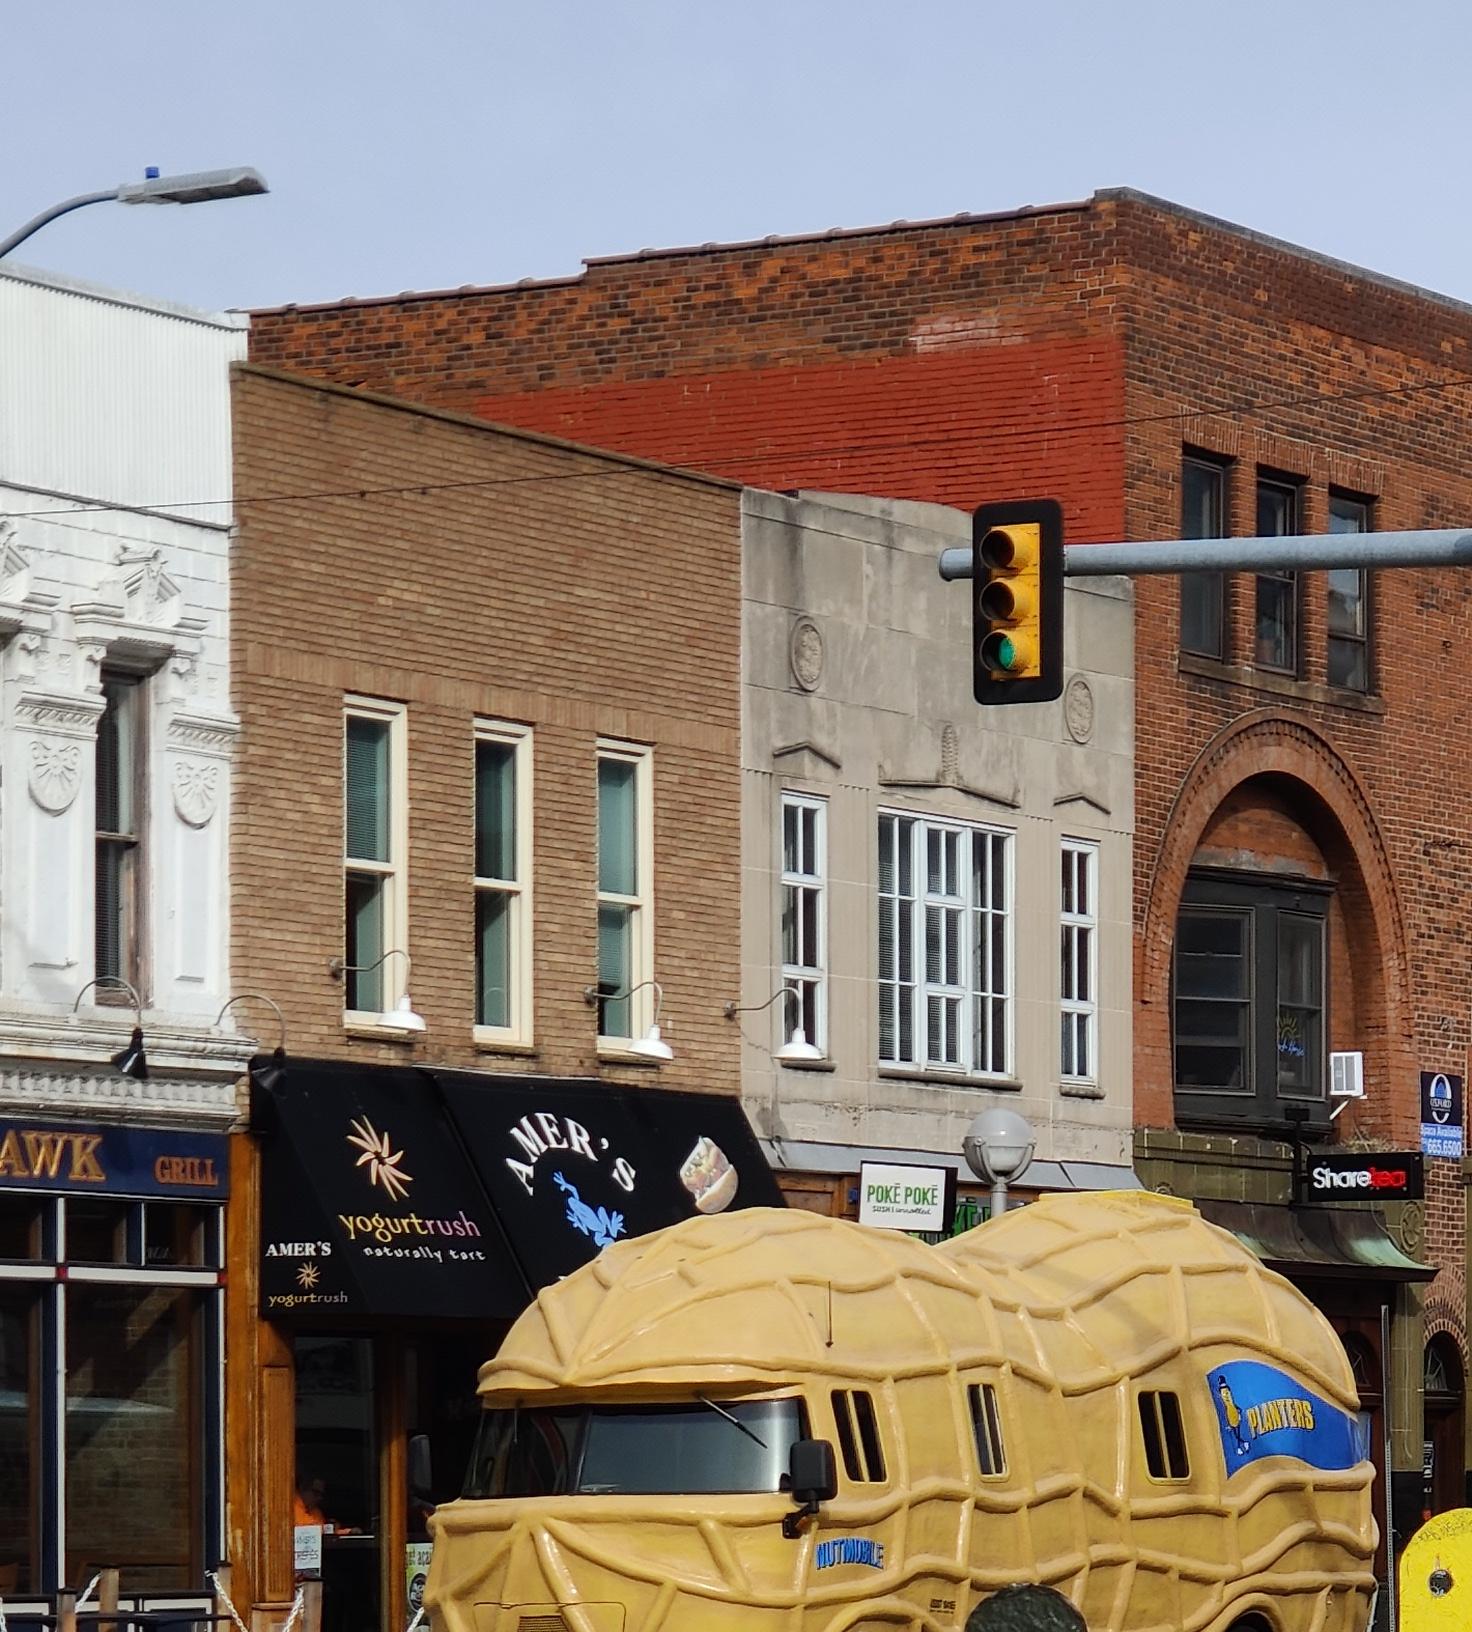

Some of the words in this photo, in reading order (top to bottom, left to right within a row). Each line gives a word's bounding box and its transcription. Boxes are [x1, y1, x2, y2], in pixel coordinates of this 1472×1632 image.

[505, 1112, 637, 1196] AMER'S
[155, 1155, 219, 1186] GRILL
[1312, 1166, 1406, 1188] Sharetea
[338, 1210, 481, 1242] yogurtrush
[265, 1241, 332, 1257] AMER'S
[363, 1246, 443, 1263] naturally
[449, 1250, 486, 1261] tart
[268, 1291, 348, 1307] yogurtrush
[1247, 1398, 1316, 1440] PLANTERS
[816, 1537, 885, 1571] NUTMOBILE
